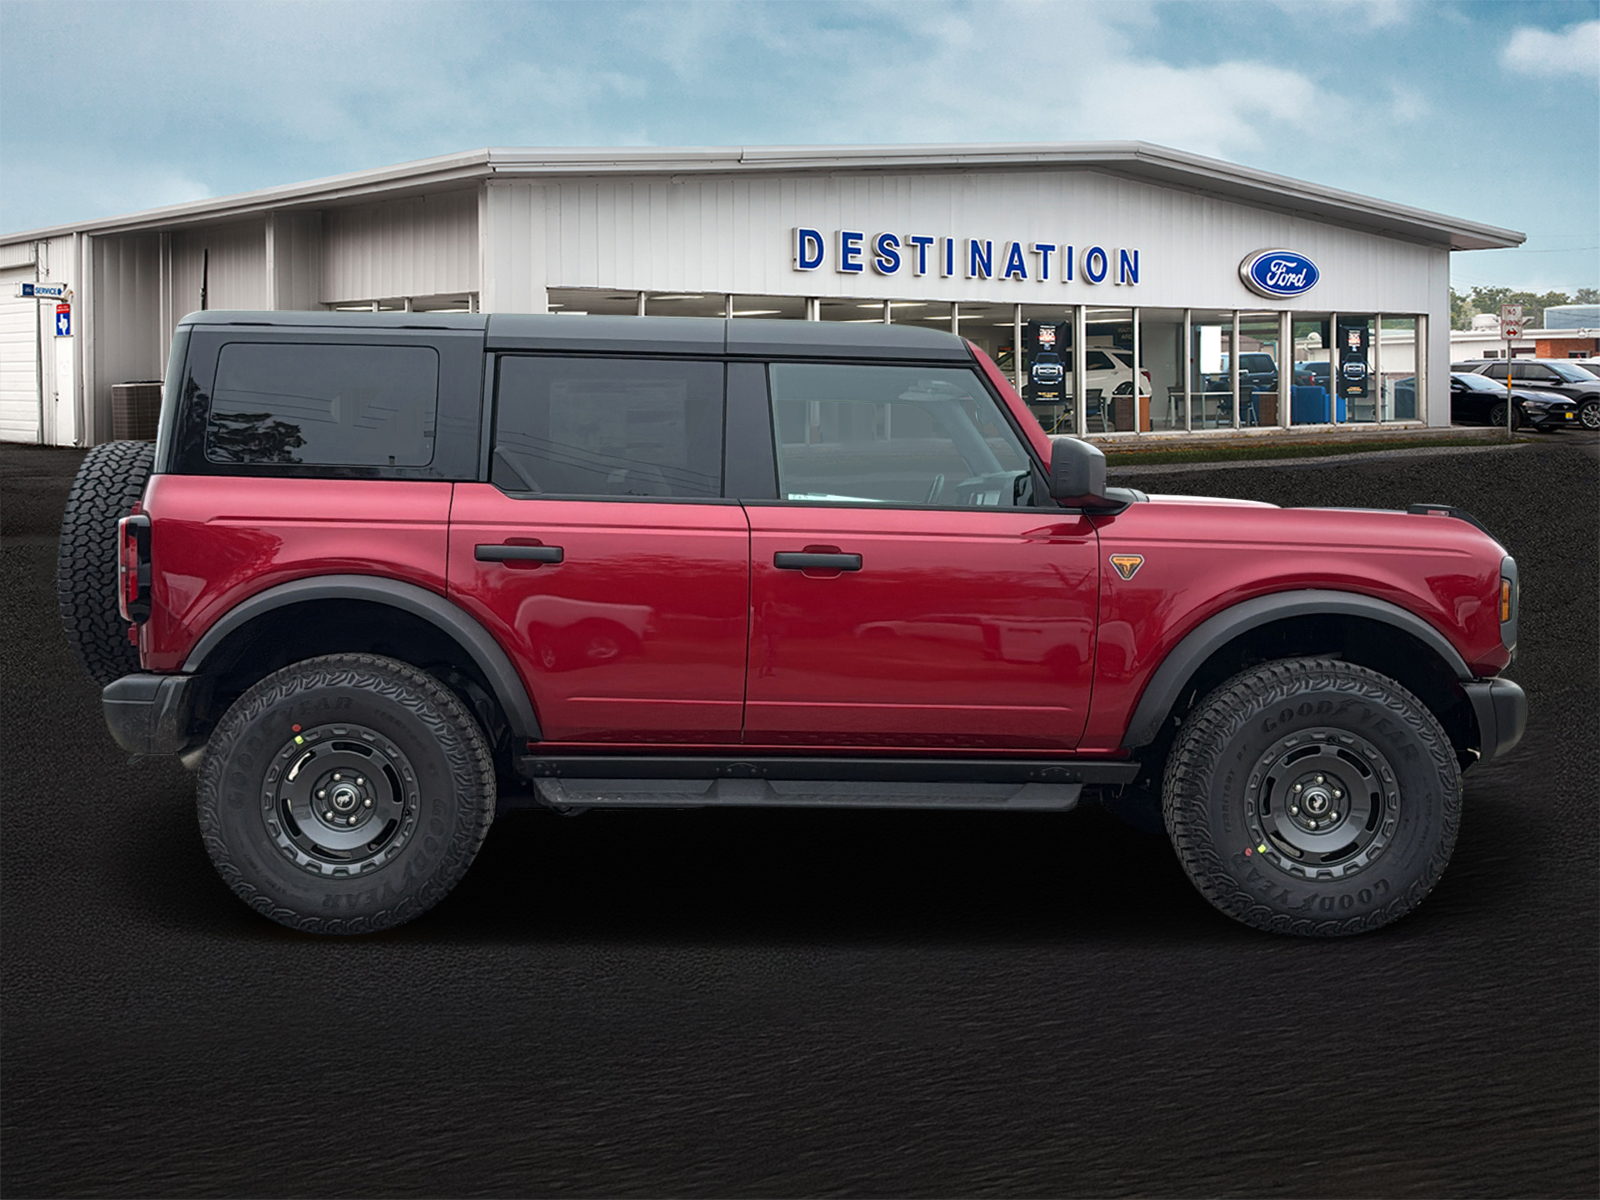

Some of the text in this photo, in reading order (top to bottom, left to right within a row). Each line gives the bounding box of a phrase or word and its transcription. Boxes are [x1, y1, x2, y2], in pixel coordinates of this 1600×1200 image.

[793, 227, 1141, 286] DESTINATION
[1266, 259, 1307, 287] Ford
[35, 287, 57, 295] SERVICE
[1502, 319, 1521, 327] PARKING
